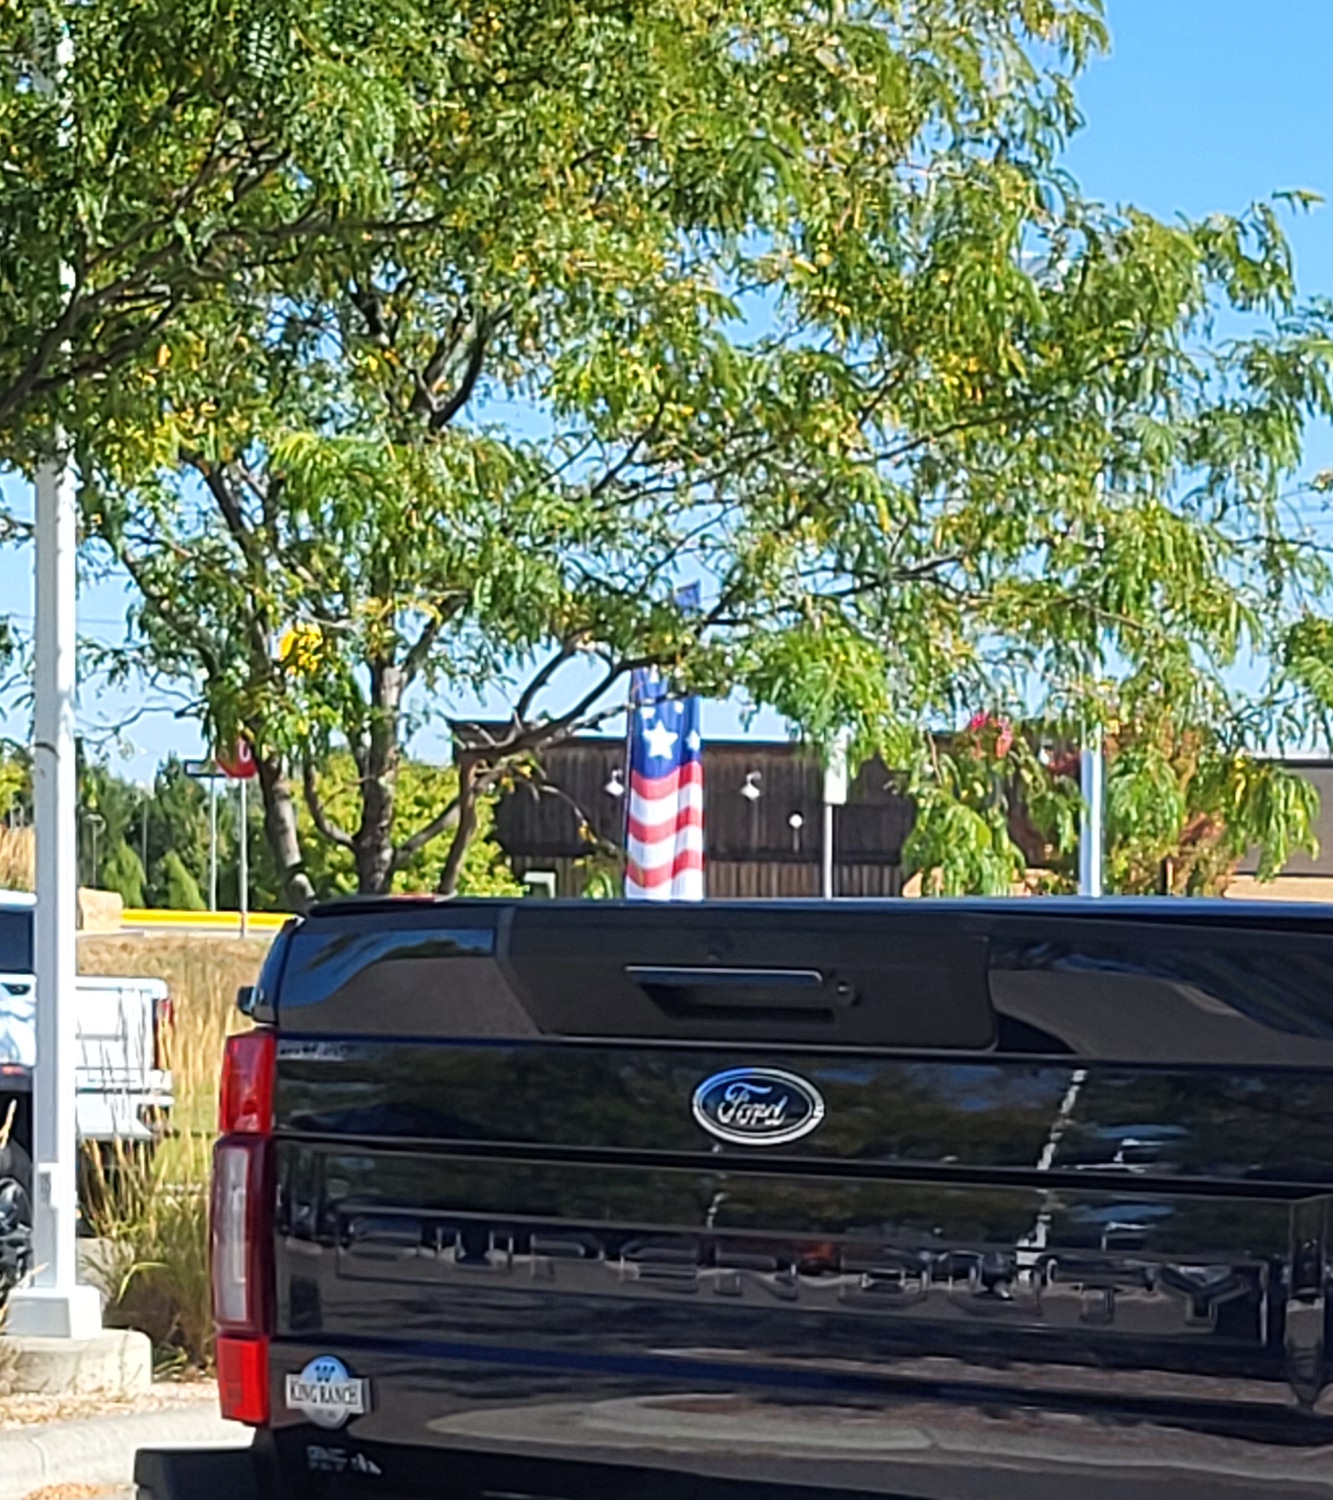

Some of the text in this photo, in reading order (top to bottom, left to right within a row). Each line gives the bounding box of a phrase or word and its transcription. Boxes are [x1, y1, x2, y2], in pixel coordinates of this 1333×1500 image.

[717, 1082, 789, 1126] Ford
[290, 1380, 358, 1406] KING RANCH
